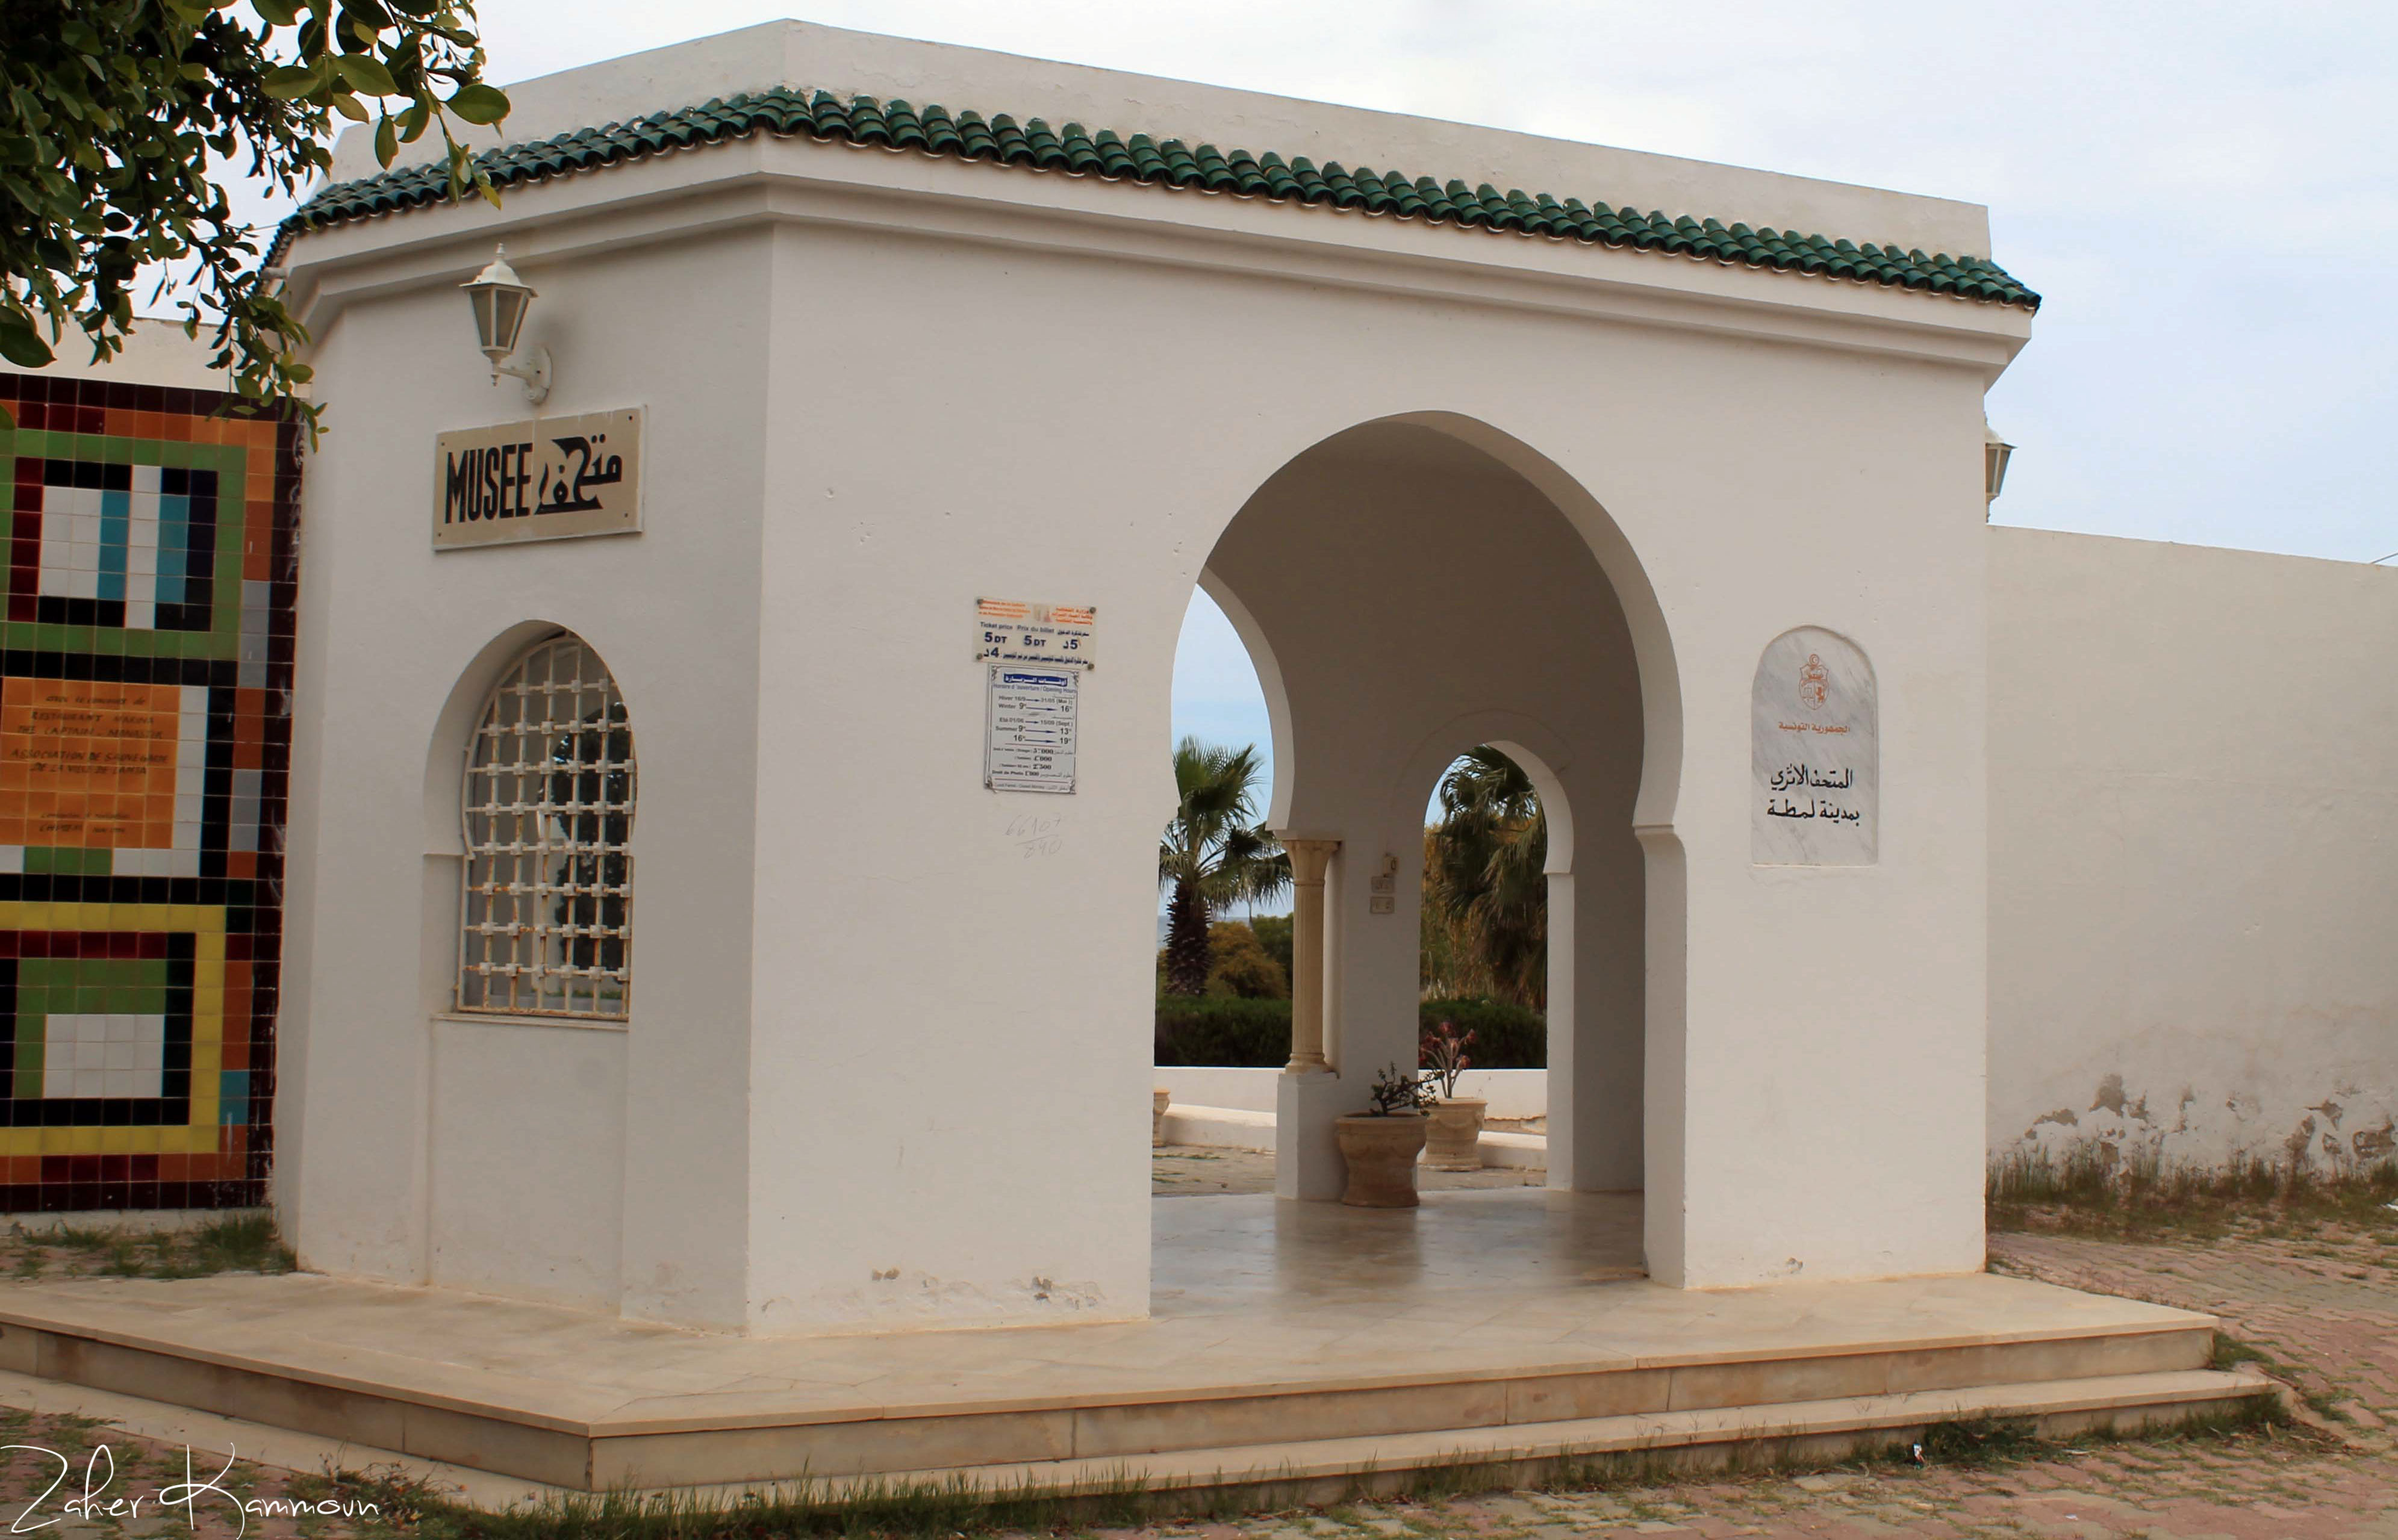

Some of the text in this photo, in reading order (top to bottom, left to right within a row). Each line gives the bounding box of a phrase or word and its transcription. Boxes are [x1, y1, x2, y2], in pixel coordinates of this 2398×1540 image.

[445, 442, 533, 524] MUSEE
[534, 433, 622, 515] متحف
[984, 632, 993, 643] 5
[1024, 635, 1032, 646] 5
[1810, 767, 1853, 789] المتحف
[1819, 800, 1860, 827] بمدينة
